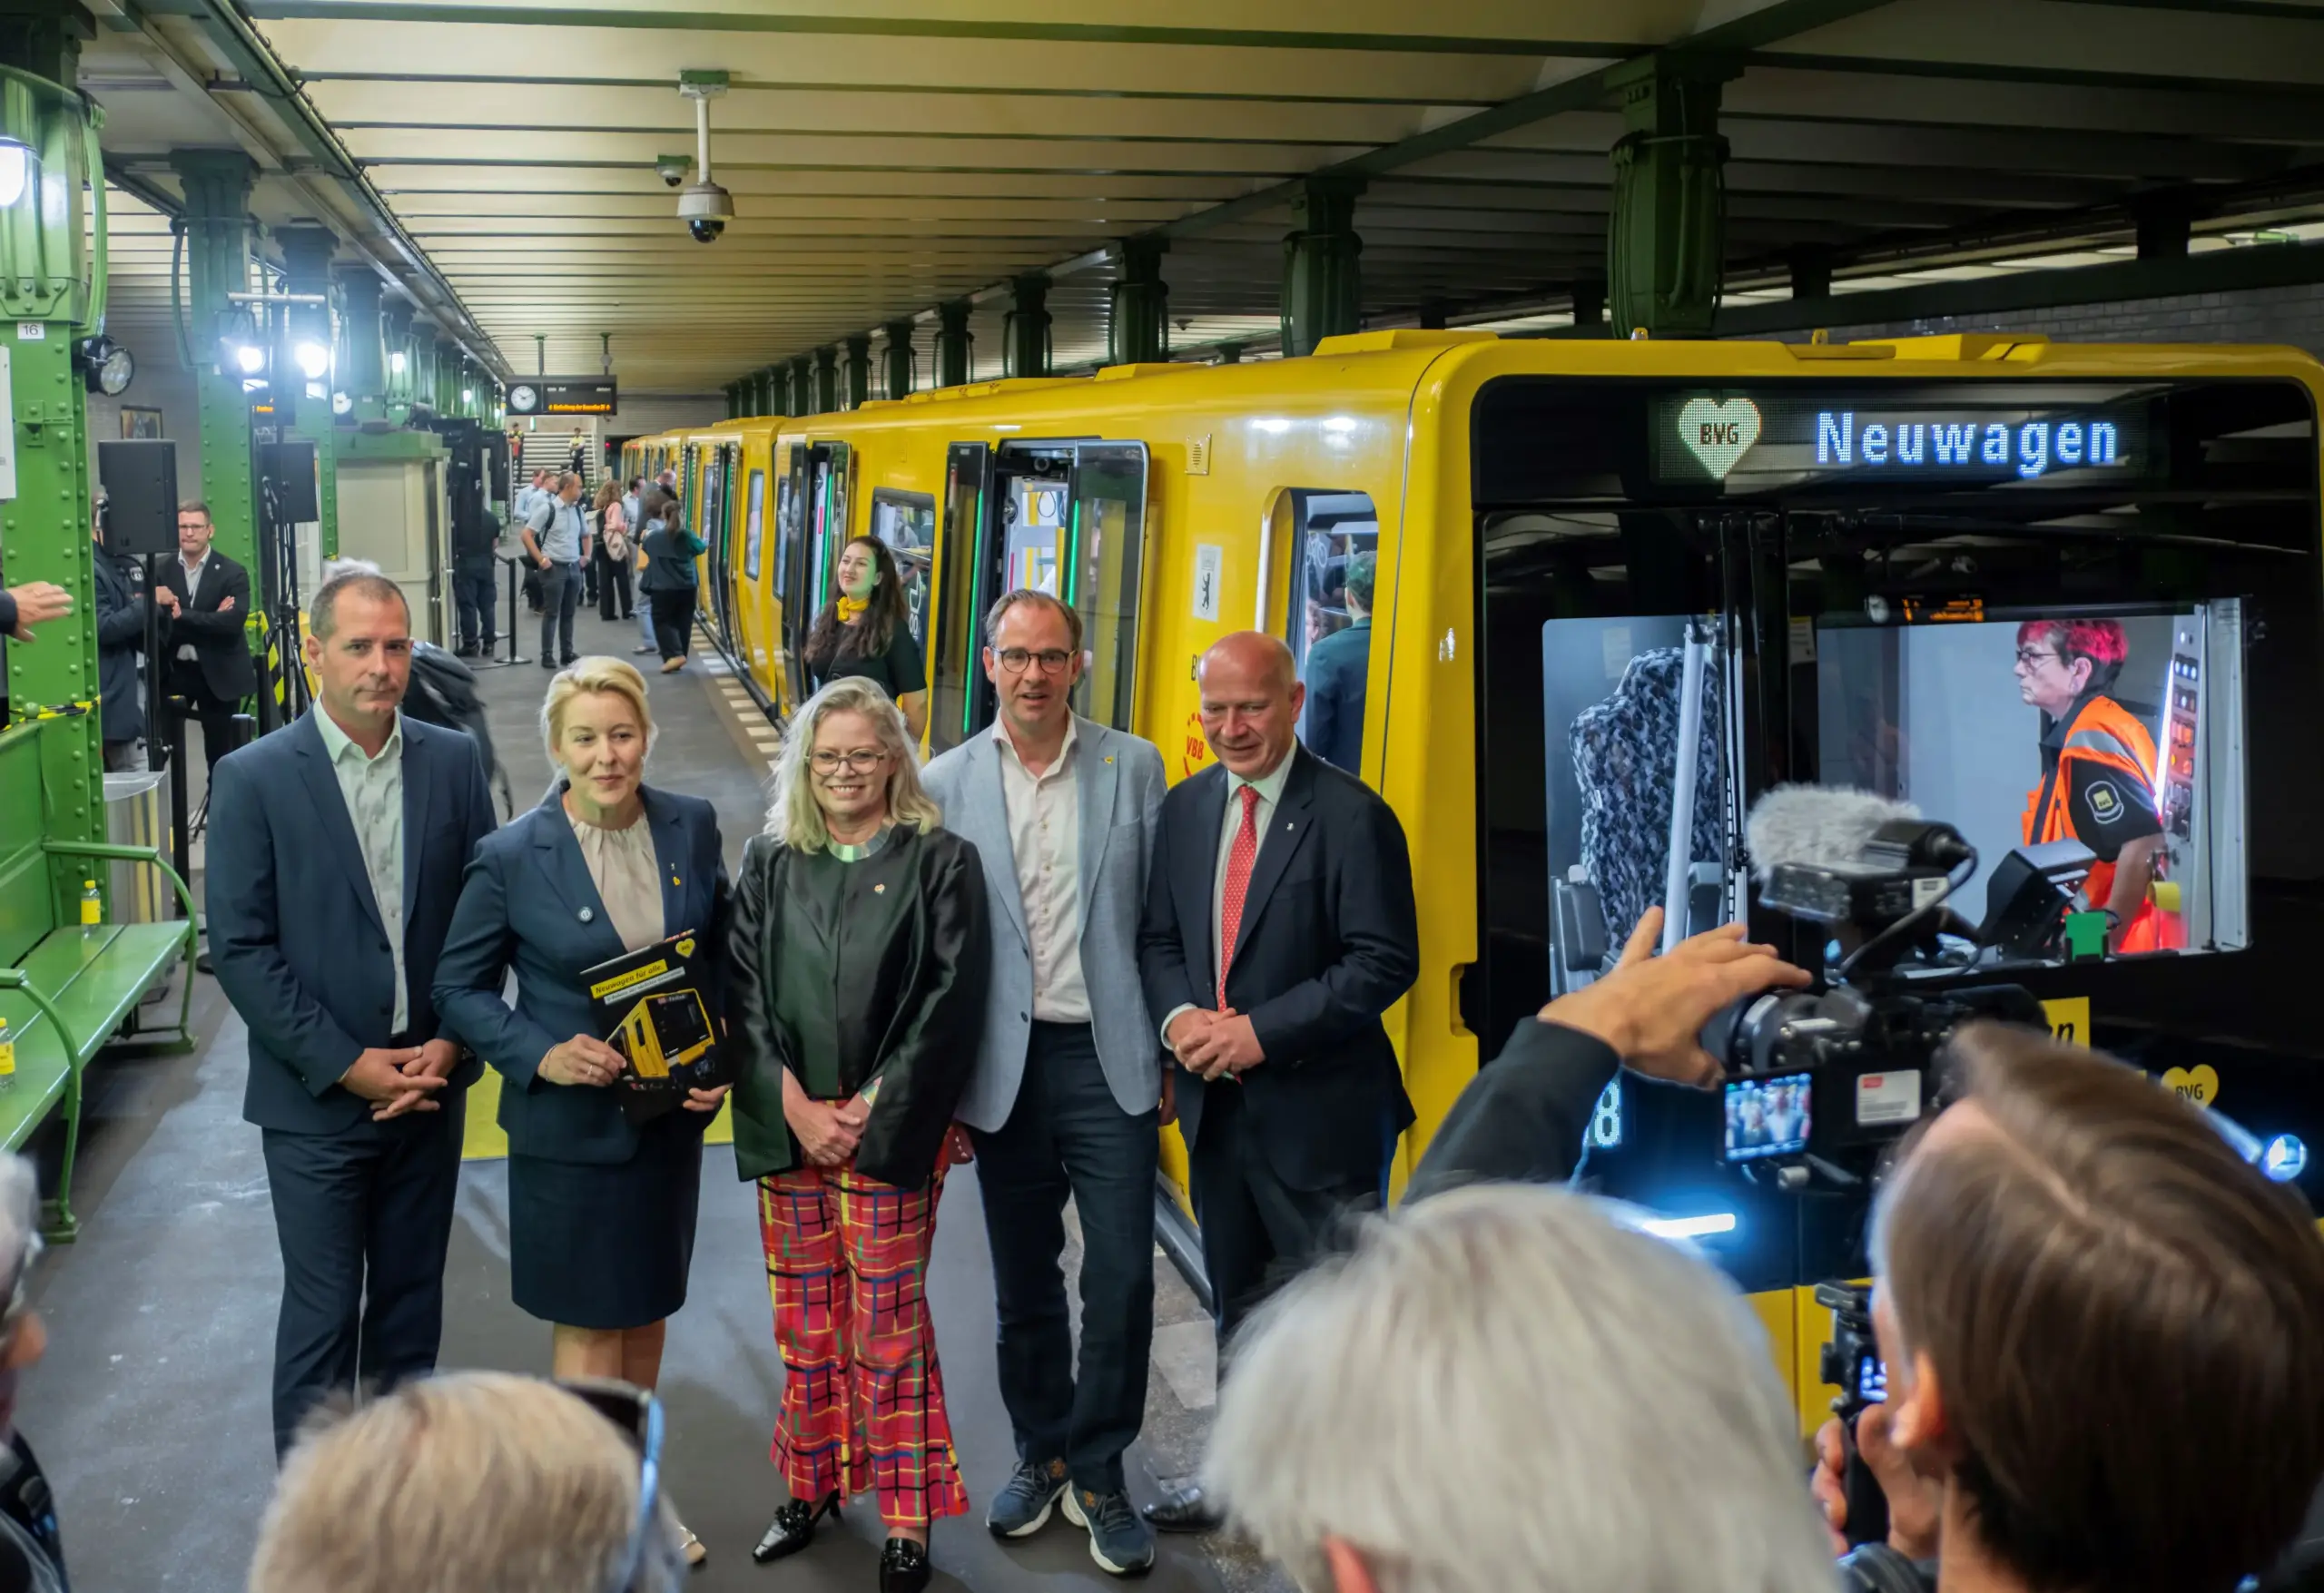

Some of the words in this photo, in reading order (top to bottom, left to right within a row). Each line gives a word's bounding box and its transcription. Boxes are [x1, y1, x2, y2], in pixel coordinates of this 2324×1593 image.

[24, 324, 39, 336] 16
[1700, 423, 1738, 445] BVG
[1817, 412, 2117, 477] Neuwagen
[1187, 734, 1204, 760] VBB
[596, 975, 635, 994] Neuwagen
